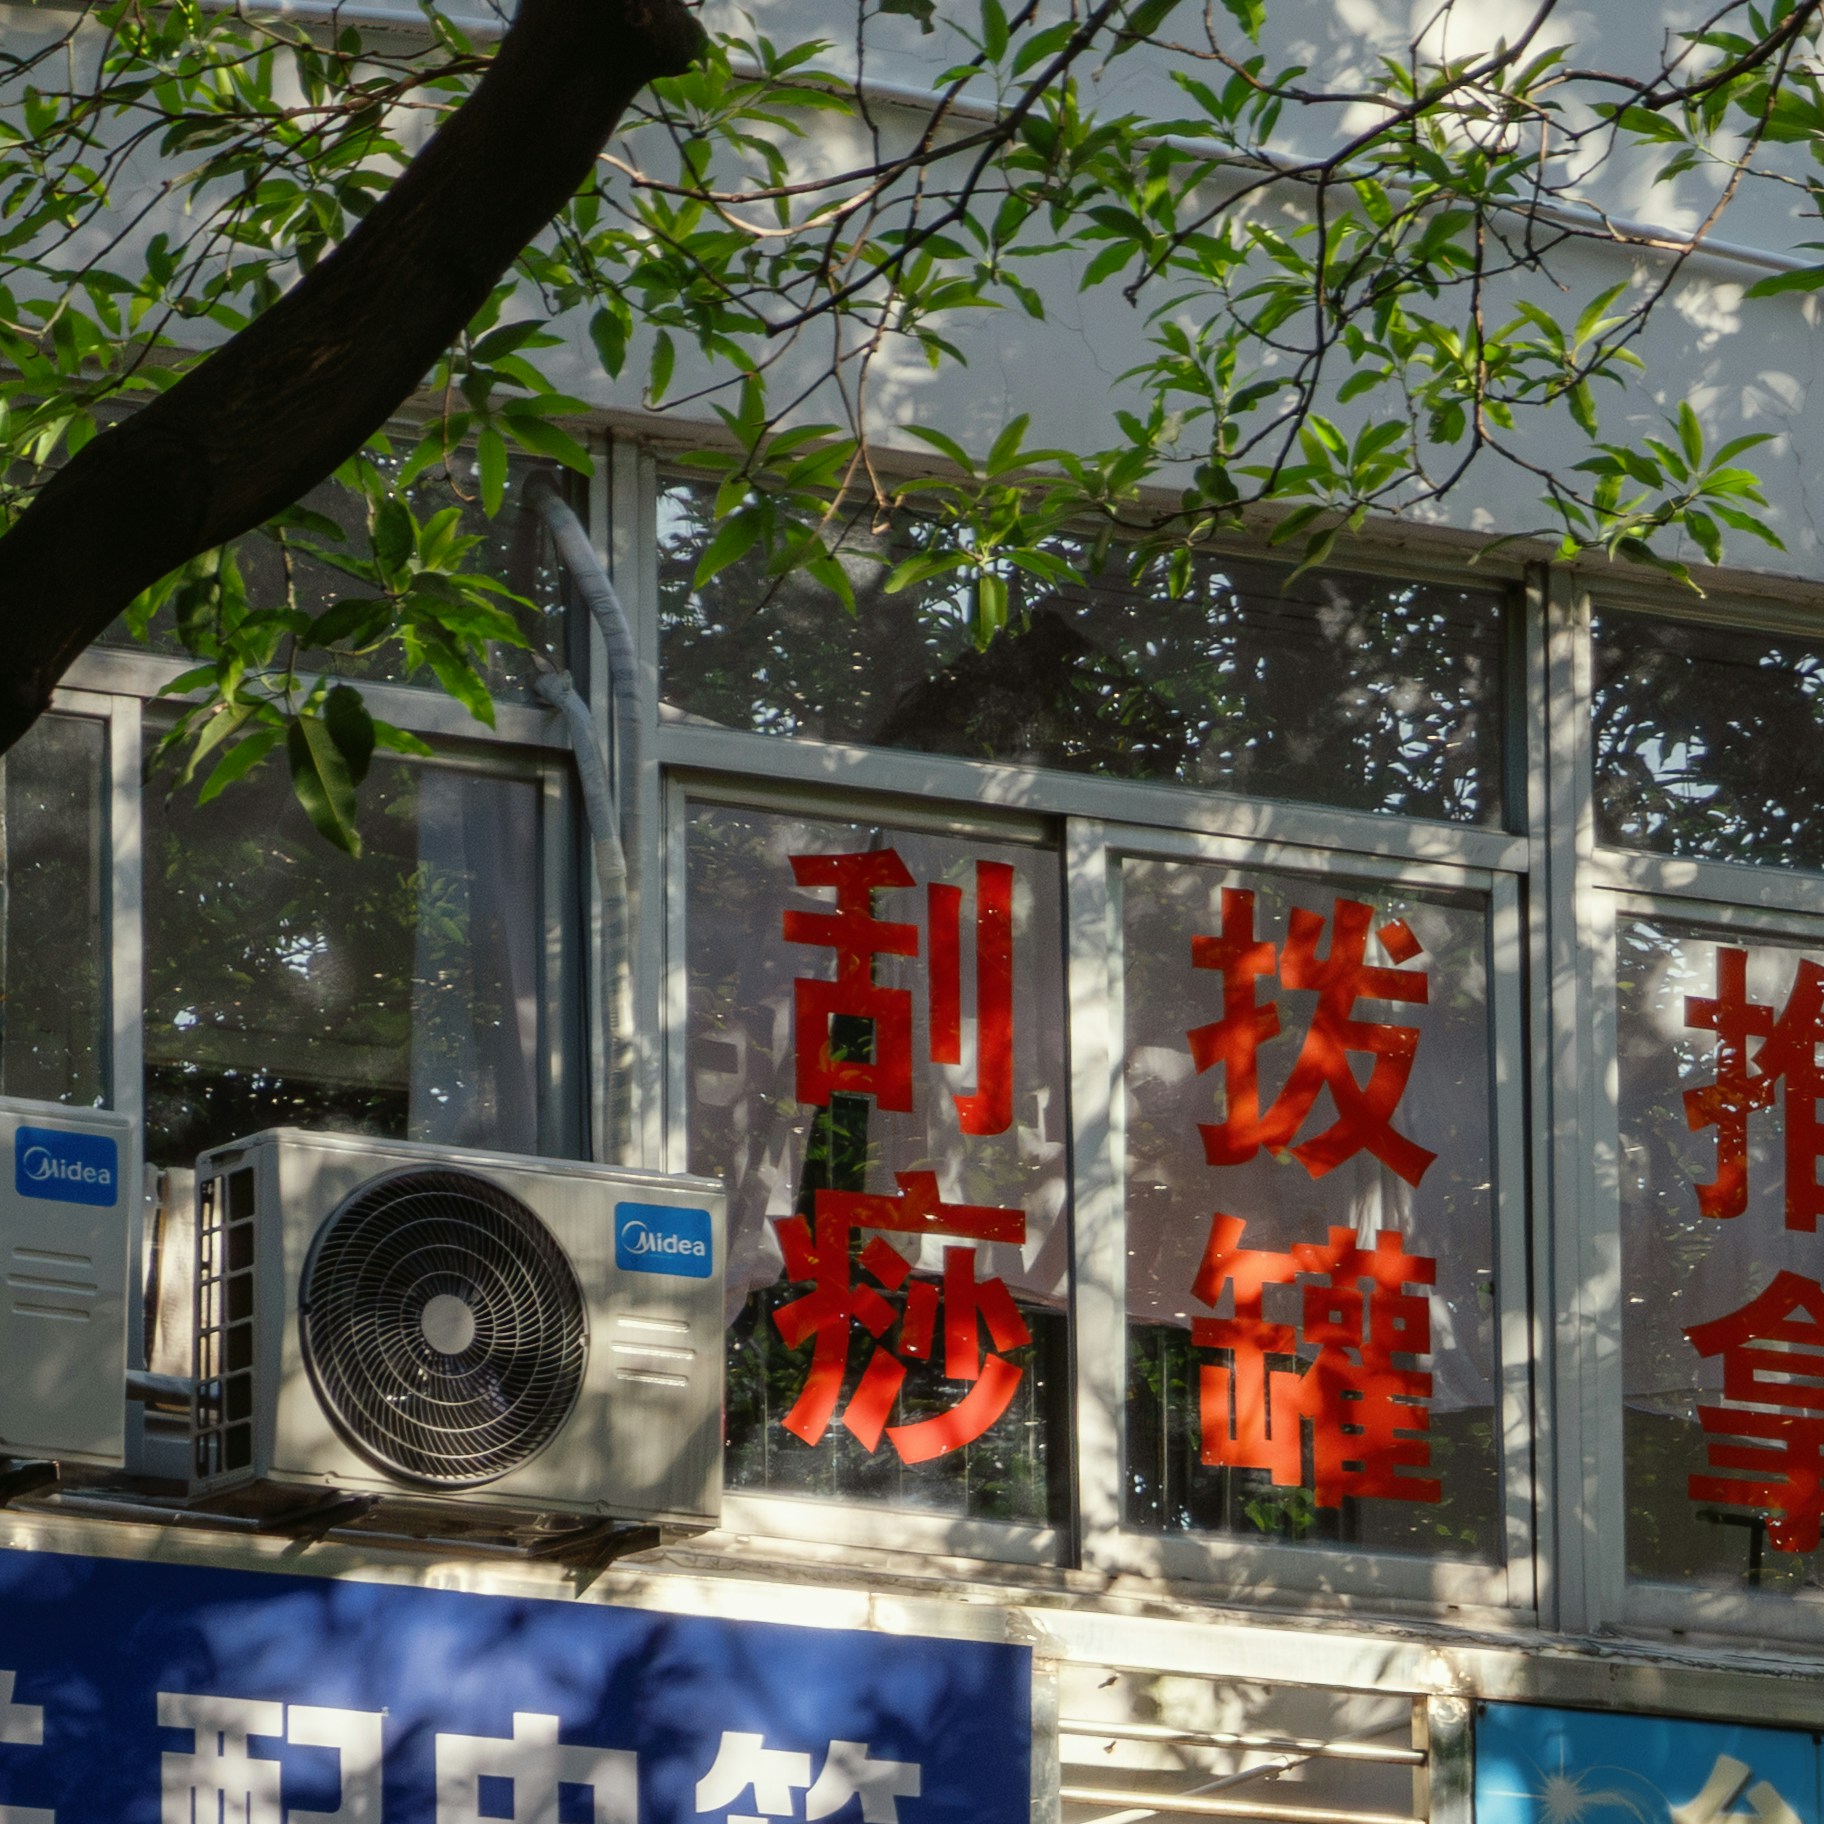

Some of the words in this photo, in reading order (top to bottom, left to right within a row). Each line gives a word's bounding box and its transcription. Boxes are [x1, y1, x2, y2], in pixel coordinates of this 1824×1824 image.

[24, 1144, 112, 1187] Midea
[772, 848, 1033, 1465] 刮痧
[621, 1220, 706, 1260] Midea
